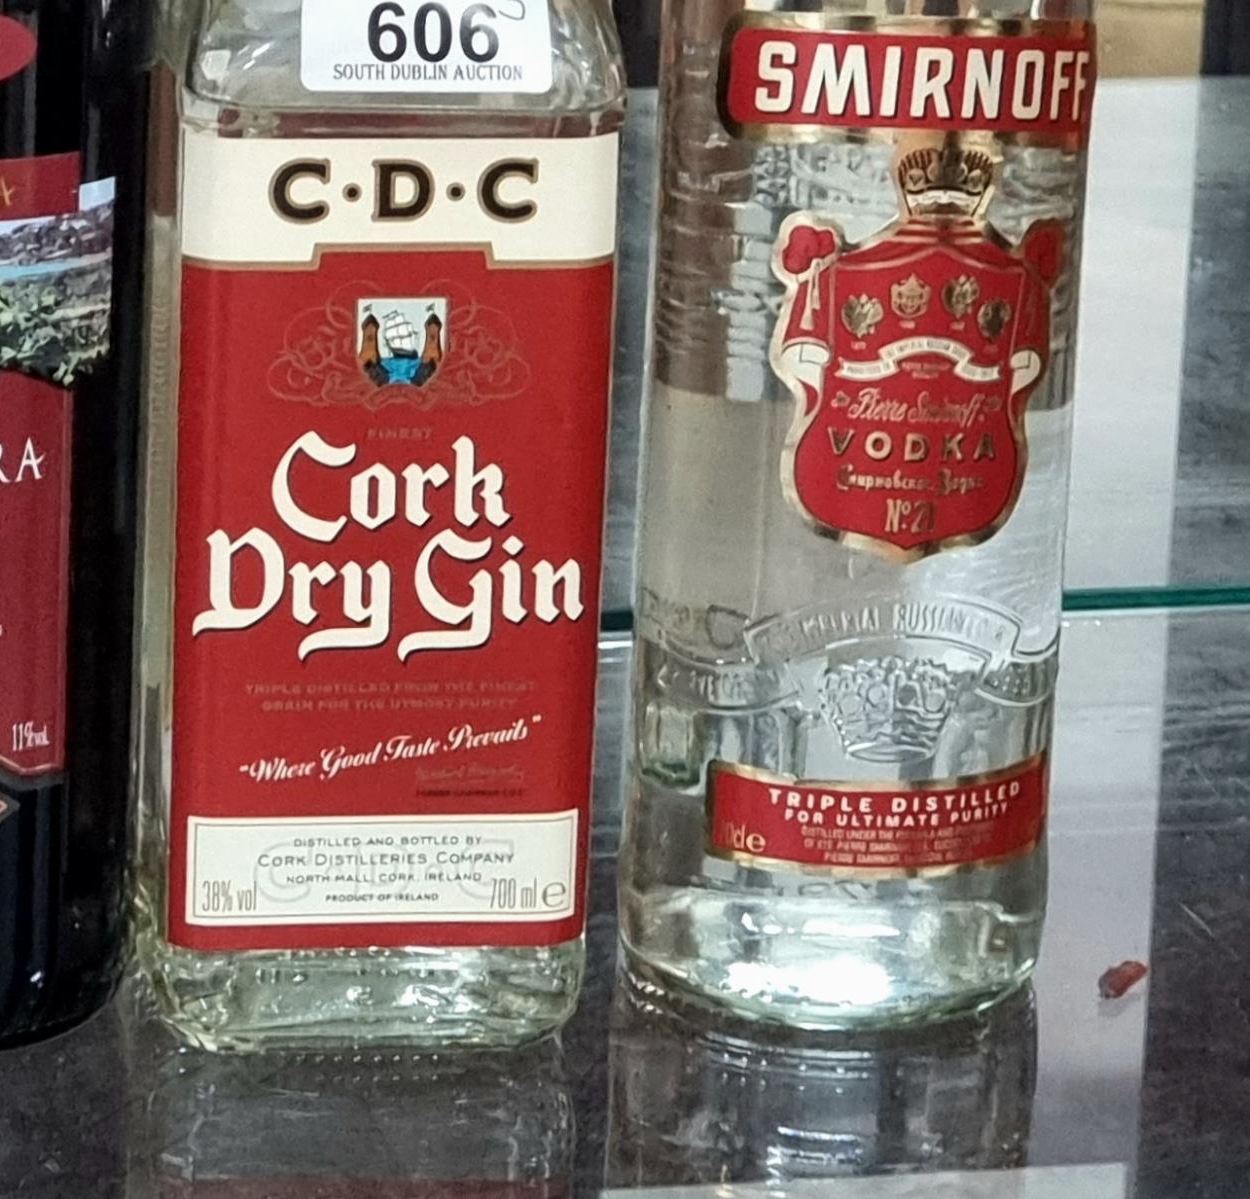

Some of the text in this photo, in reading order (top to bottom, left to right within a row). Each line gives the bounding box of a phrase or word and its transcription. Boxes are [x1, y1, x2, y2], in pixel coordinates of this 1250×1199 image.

[367, 1, 499, 63] 606
[332, 63, 523, 81] SOUTH DUBLIN AUCTION
[754, 40, 1089, 120] SMIRNOFF
[827, 426, 995, 462] VODKA
[271, 430, 513, 544] Cork
[191, 527, 586, 664] Dry Gin
[319, 741, 382, 781] Good
[383, 735, 441, 761] Taste
[768, 781, 1020, 813] TRIPLE DISTILLED
[785, 809, 824, 824] FOR
[836, 811, 940, 827] ULTIMATE
[950, 803, 1009, 822] PURITY
[294, 835, 483, 848] DISTILLED AND BOTTLED BY
[257, 850, 515, 868] CORK DISTILLERIES COMPANY
[286, 873, 330, 884] NORTH
[424, 871, 482, 882] IRELAND
[490, 878, 517, 909] 700
[521, 878, 537, 908] ml
[202, 880, 257, 912] 38% vol
[325, 892, 439, 902] PRODUCT OF IRELAND
